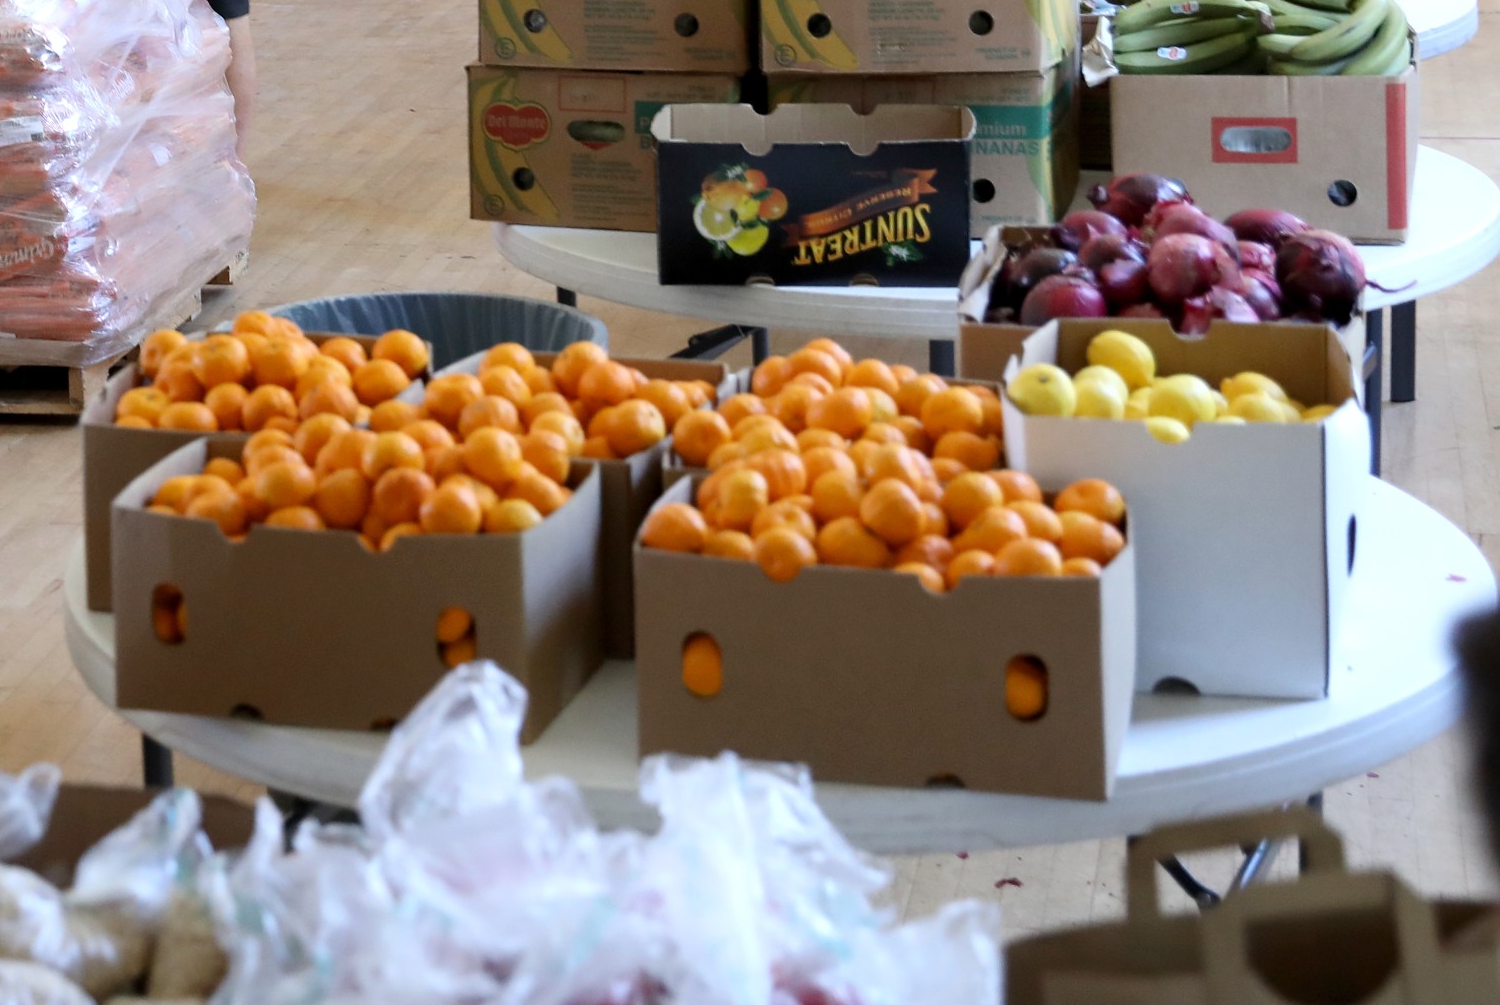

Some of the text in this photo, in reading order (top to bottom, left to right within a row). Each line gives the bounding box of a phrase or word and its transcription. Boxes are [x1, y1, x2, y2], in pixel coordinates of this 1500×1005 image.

[488, 114, 506, 128] Del
[976, 123, 1027, 137] mium
[975, 141, 1039, 157] NANAS
[791, 203, 931, 266] SUNTREAT
